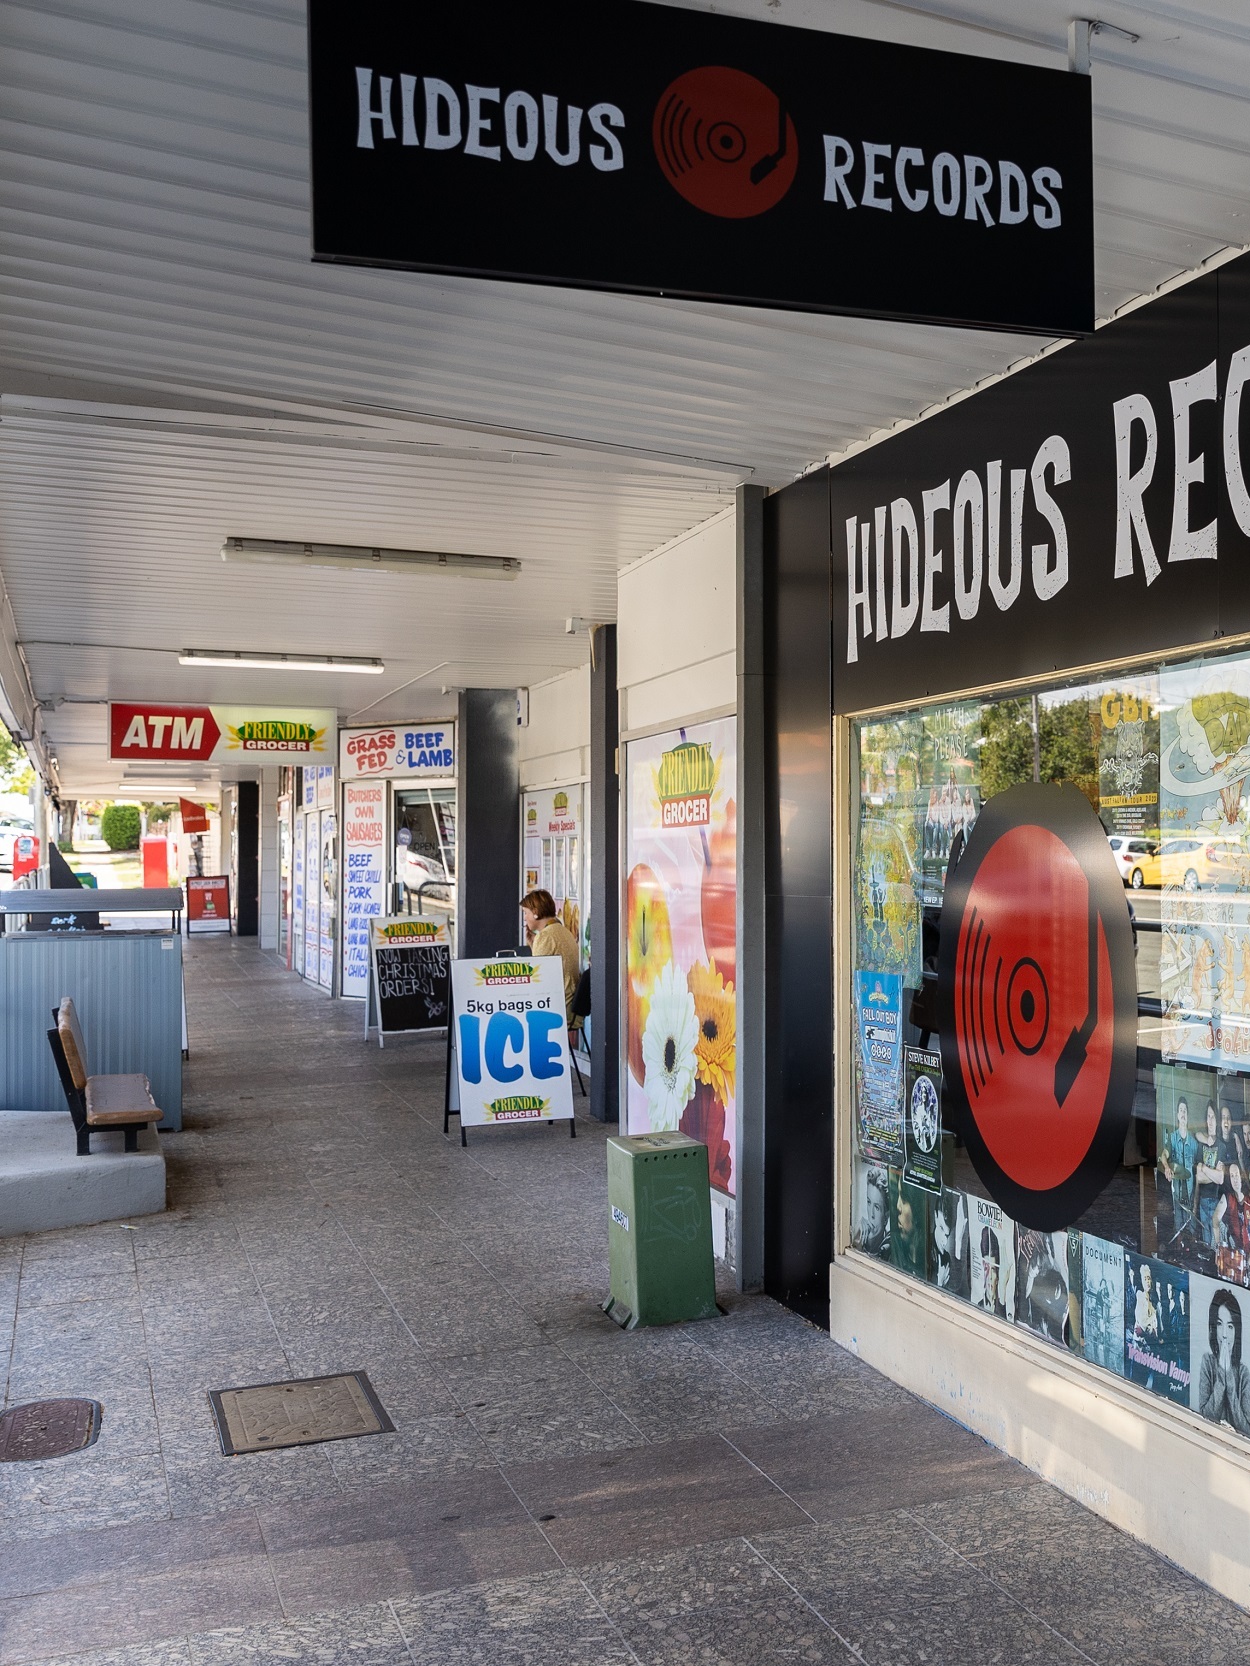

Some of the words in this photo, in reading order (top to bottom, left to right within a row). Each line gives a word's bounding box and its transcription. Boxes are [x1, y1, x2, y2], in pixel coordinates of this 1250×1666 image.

[354, 66, 625, 172] HIDEOUS
[822, 133, 1064, 230] RECORDS
[845, 434, 1072, 664] HIDEOUS
[1101, 680, 1160, 730] GBH
[934, 706, 966, 731] MITCH
[120, 714, 205, 750] ATM
[242, 721, 313, 741] FRIENDLY
[404, 732, 444, 749] BEEF
[245, 741, 307, 751] GROCER
[346, 733, 396, 756] GRASS
[934, 733, 969, 762] PLEASE
[356, 751, 388, 771] FED
[408, 749, 453, 768] LAMB
[661, 741, 712, 797] FRIENDLY
[354, 806, 374, 819] OWN
[663, 798, 708, 825] GROCER
[346, 822, 383, 841] SAUSAGES
[348, 854, 373, 867] BEEF
[347, 886, 372, 899] PORK
[347, 902, 361, 914] PORK
[387, 921, 436, 937] FRIENDLY
[390, 935, 434, 944] GROCER
[348, 947, 368, 962] ITALI
[377, 948, 401, 963] NOW
[406, 945, 449, 962] TAKING
[378, 961, 447, 981] CHRISTMAS
[484, 962, 531, 978] FRIENDLY
[379, 978, 436, 999] ORDERS!
[486, 976, 531, 985] GROCER
[466, 999, 494, 1015] 5kg
[499, 999, 533, 1014] bags
[537, 997, 551, 1010] of
[862, 1007, 876, 1022] FALL
[876, 1009, 885, 1023] OUT
[885, 1011, 897, 1025] BOY
[458, 1010, 564, 1085] ICE
[494, 1096, 541, 1112] FRIENDLY
[496, 1110, 540, 1120] GROCER
[977, 1200, 1003, 1222] BOWIE!
[1085, 1245, 1122, 1268] DOCUMENT
[1127, 1342, 1168, 1376] Transvision
[1168, 1360, 1190, 1388] Vamp
